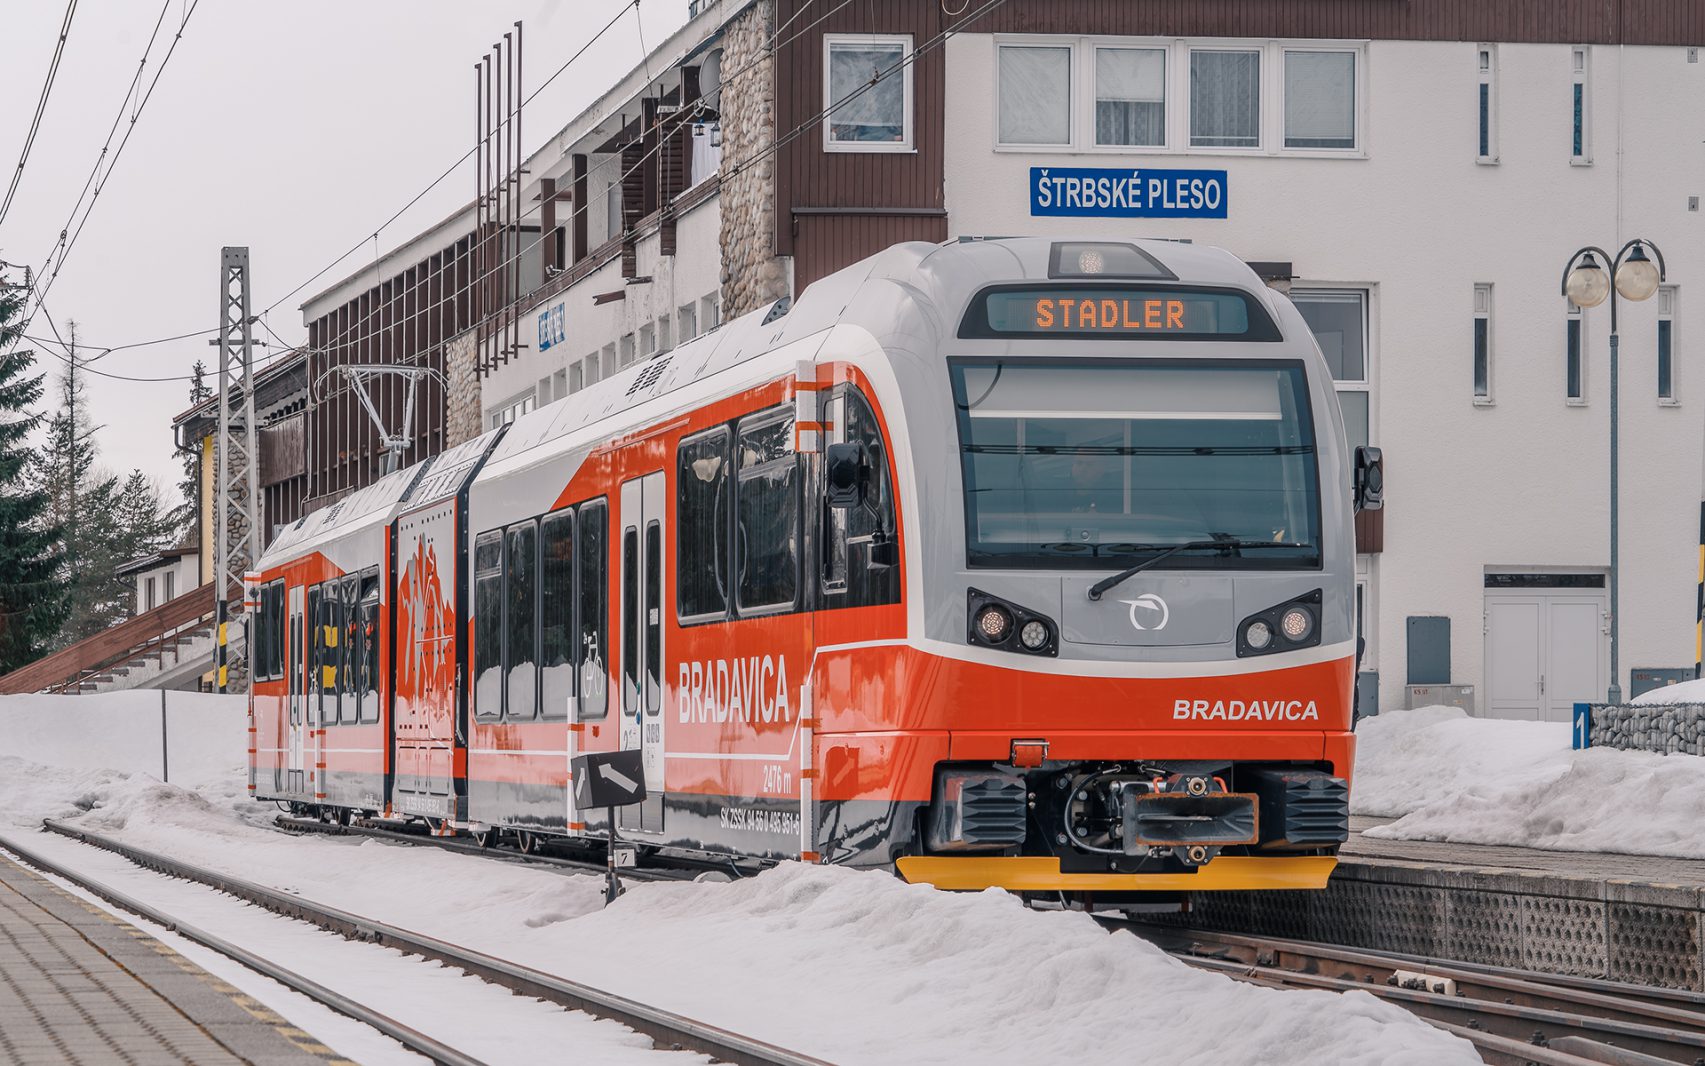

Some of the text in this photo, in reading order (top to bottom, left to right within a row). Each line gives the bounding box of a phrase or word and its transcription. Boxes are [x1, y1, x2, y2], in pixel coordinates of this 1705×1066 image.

[1038, 169, 1221, 210] ŠTRBSKÉ PLESO
[1036, 300, 1185, 328] STADLER
[679, 654, 790, 723] BRADAVICA
[1173, 700, 1319, 720] BRADAVICA
[1576, 711, 1585, 750] 1
[763, 765, 792, 794] 2476 m
[720, 807, 730, 829] SK
[730, 808, 747, 830] ZSSK
[755, 810, 764, 832] 56
[764, 810, 769, 832] 0
[621, 852, 628, 865] 7
